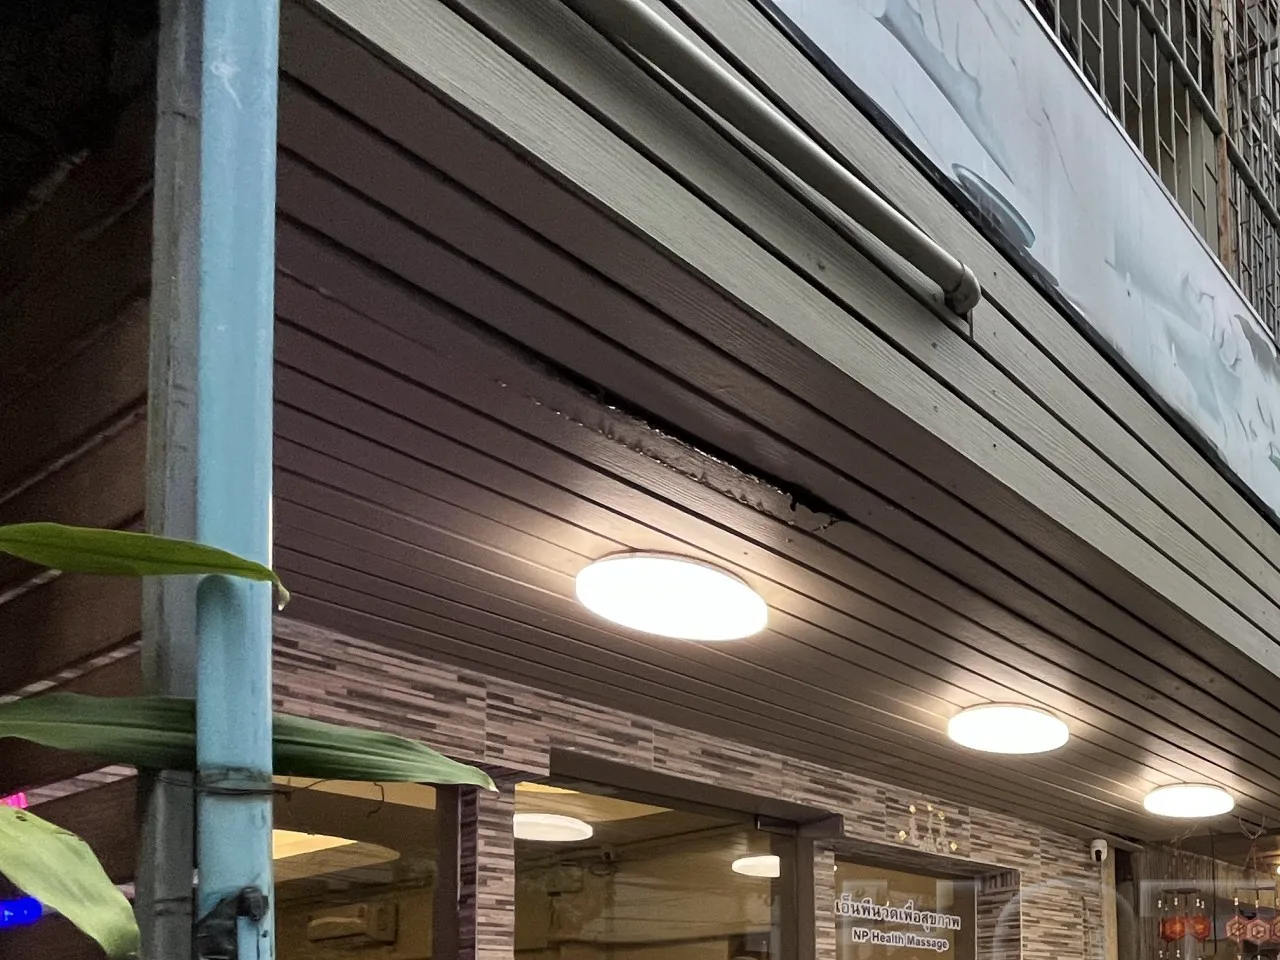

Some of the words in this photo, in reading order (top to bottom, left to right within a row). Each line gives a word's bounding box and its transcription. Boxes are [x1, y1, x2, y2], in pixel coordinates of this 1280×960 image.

[835, 894, 961, 932] เอ็นพีนวดเพื่อสุขภาพ
[853, 928, 869, 942] NP
[871, 931, 904, 945] Health
[906, 935, 949, 952] Massage
